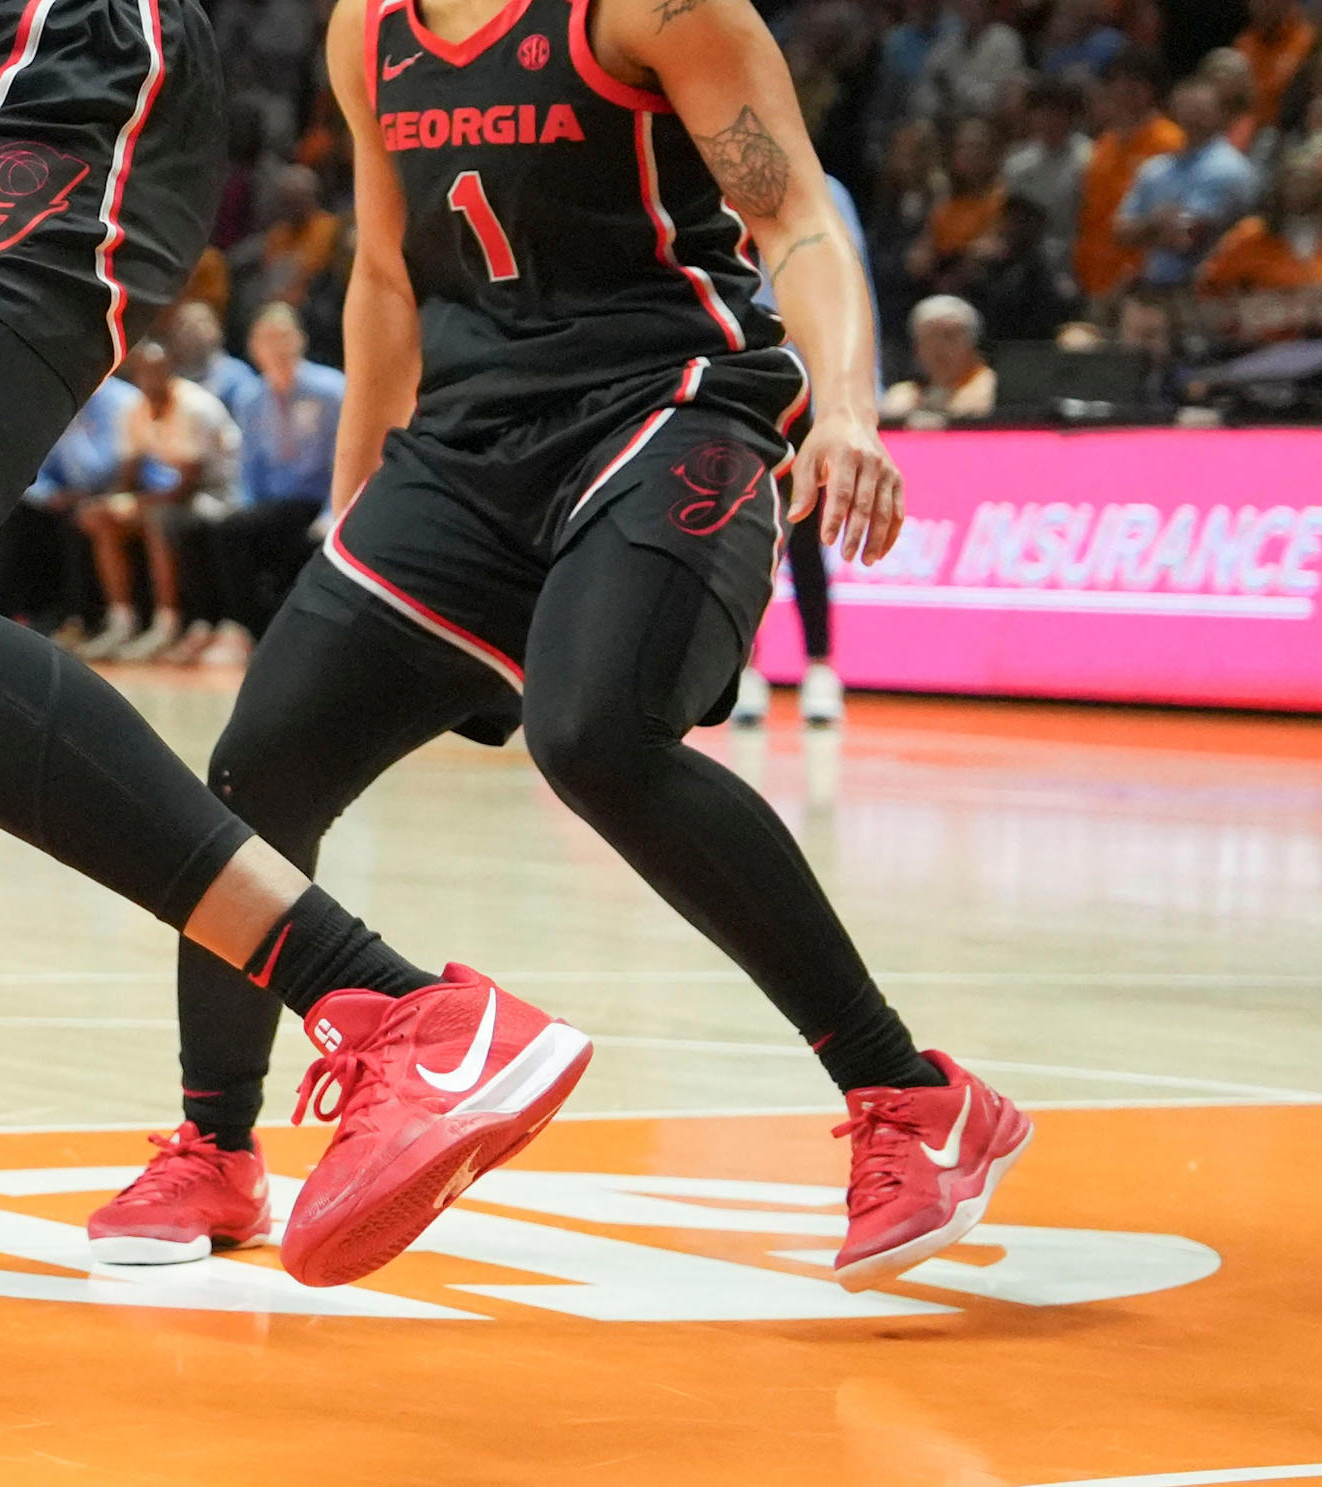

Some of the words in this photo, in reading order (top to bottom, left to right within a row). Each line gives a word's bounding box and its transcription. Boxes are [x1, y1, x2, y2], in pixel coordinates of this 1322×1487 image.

[379, 103, 586, 152] GEORGIA
[447, 171, 519, 282] 1
[953, 501, 1322, 592] INSURANCE
